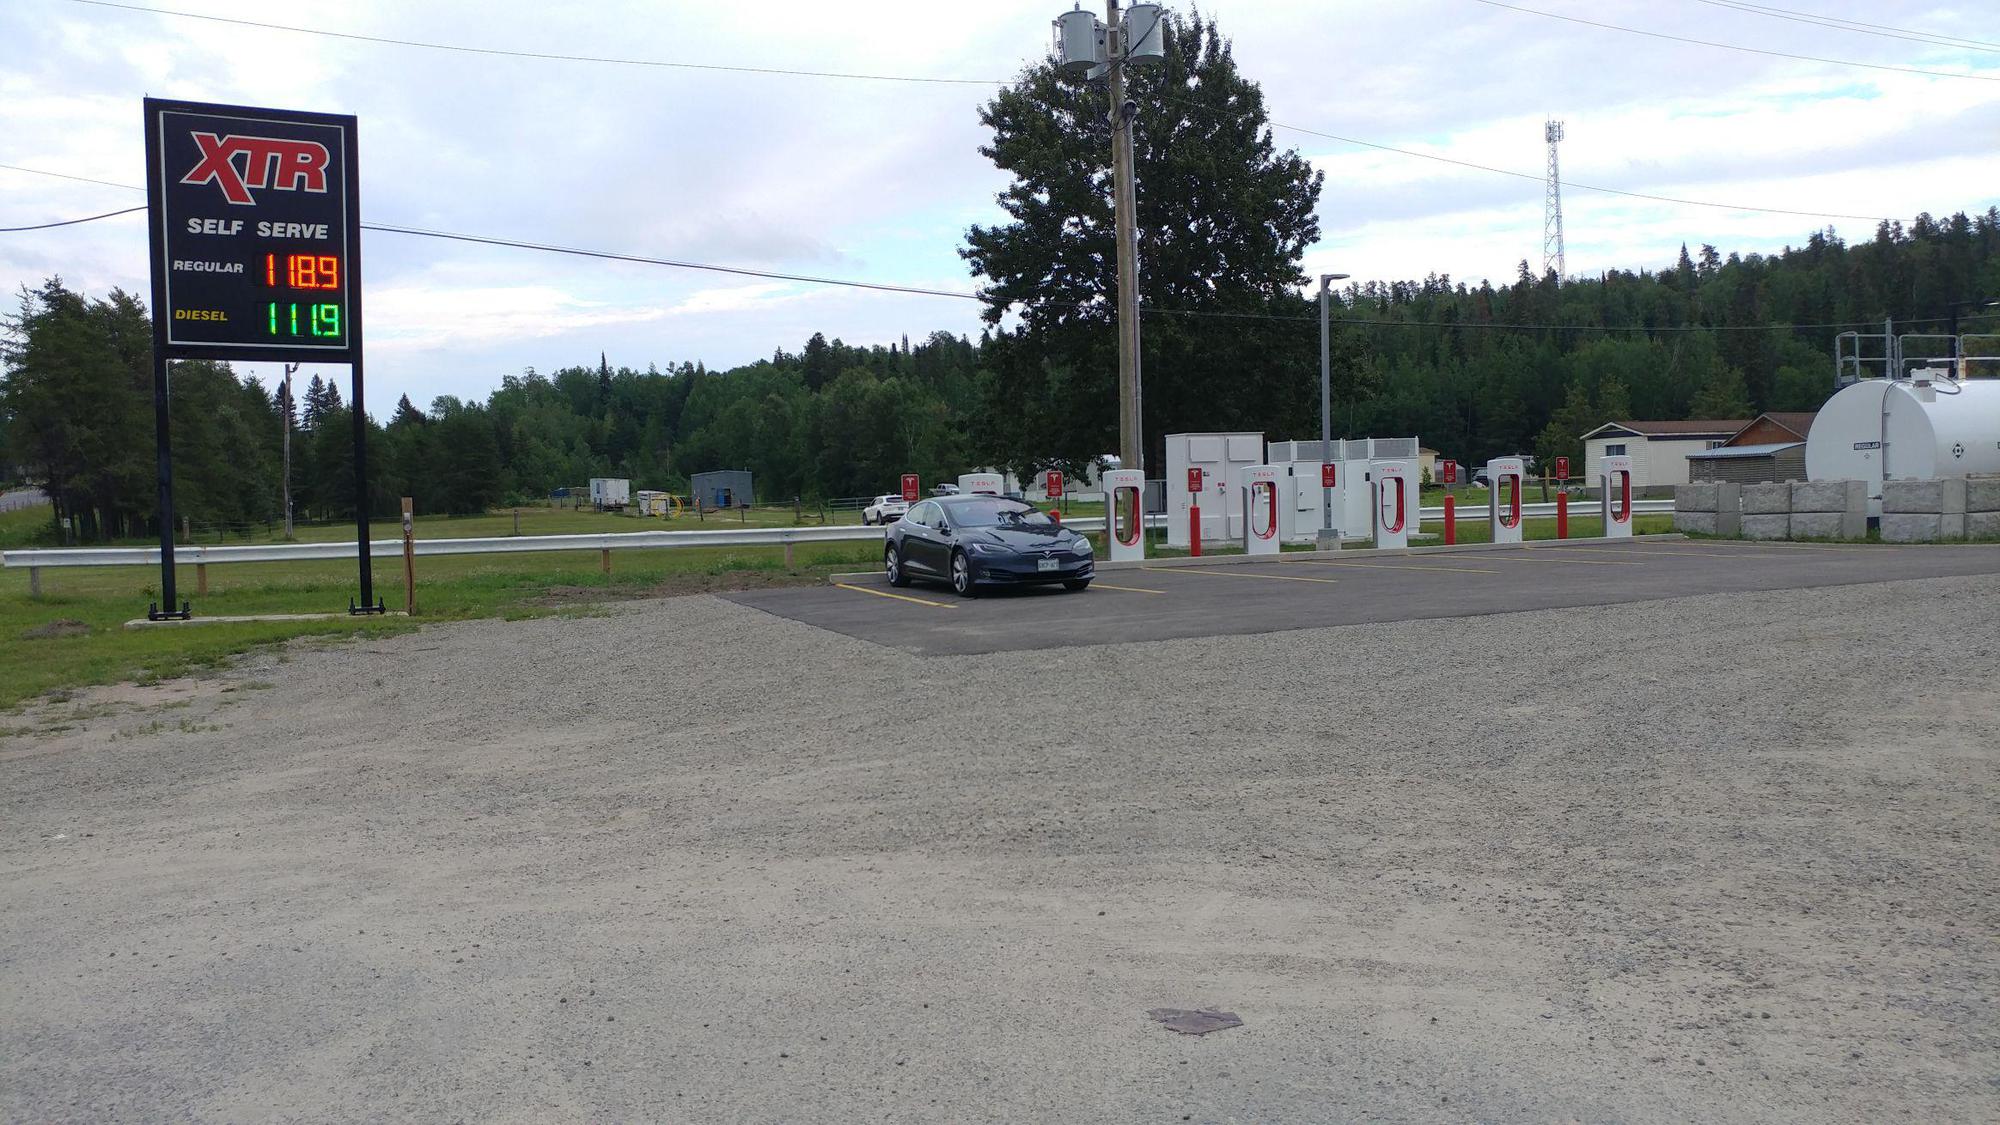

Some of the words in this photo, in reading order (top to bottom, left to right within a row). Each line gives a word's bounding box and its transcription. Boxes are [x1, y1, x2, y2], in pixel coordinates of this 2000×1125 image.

[179, 131, 330, 205] XTR
[187, 217, 244, 236] SELF
[256, 221, 329, 240] SERVE
[173, 260, 244, 274] REGULAR
[175, 309, 228, 321] DIESEL
